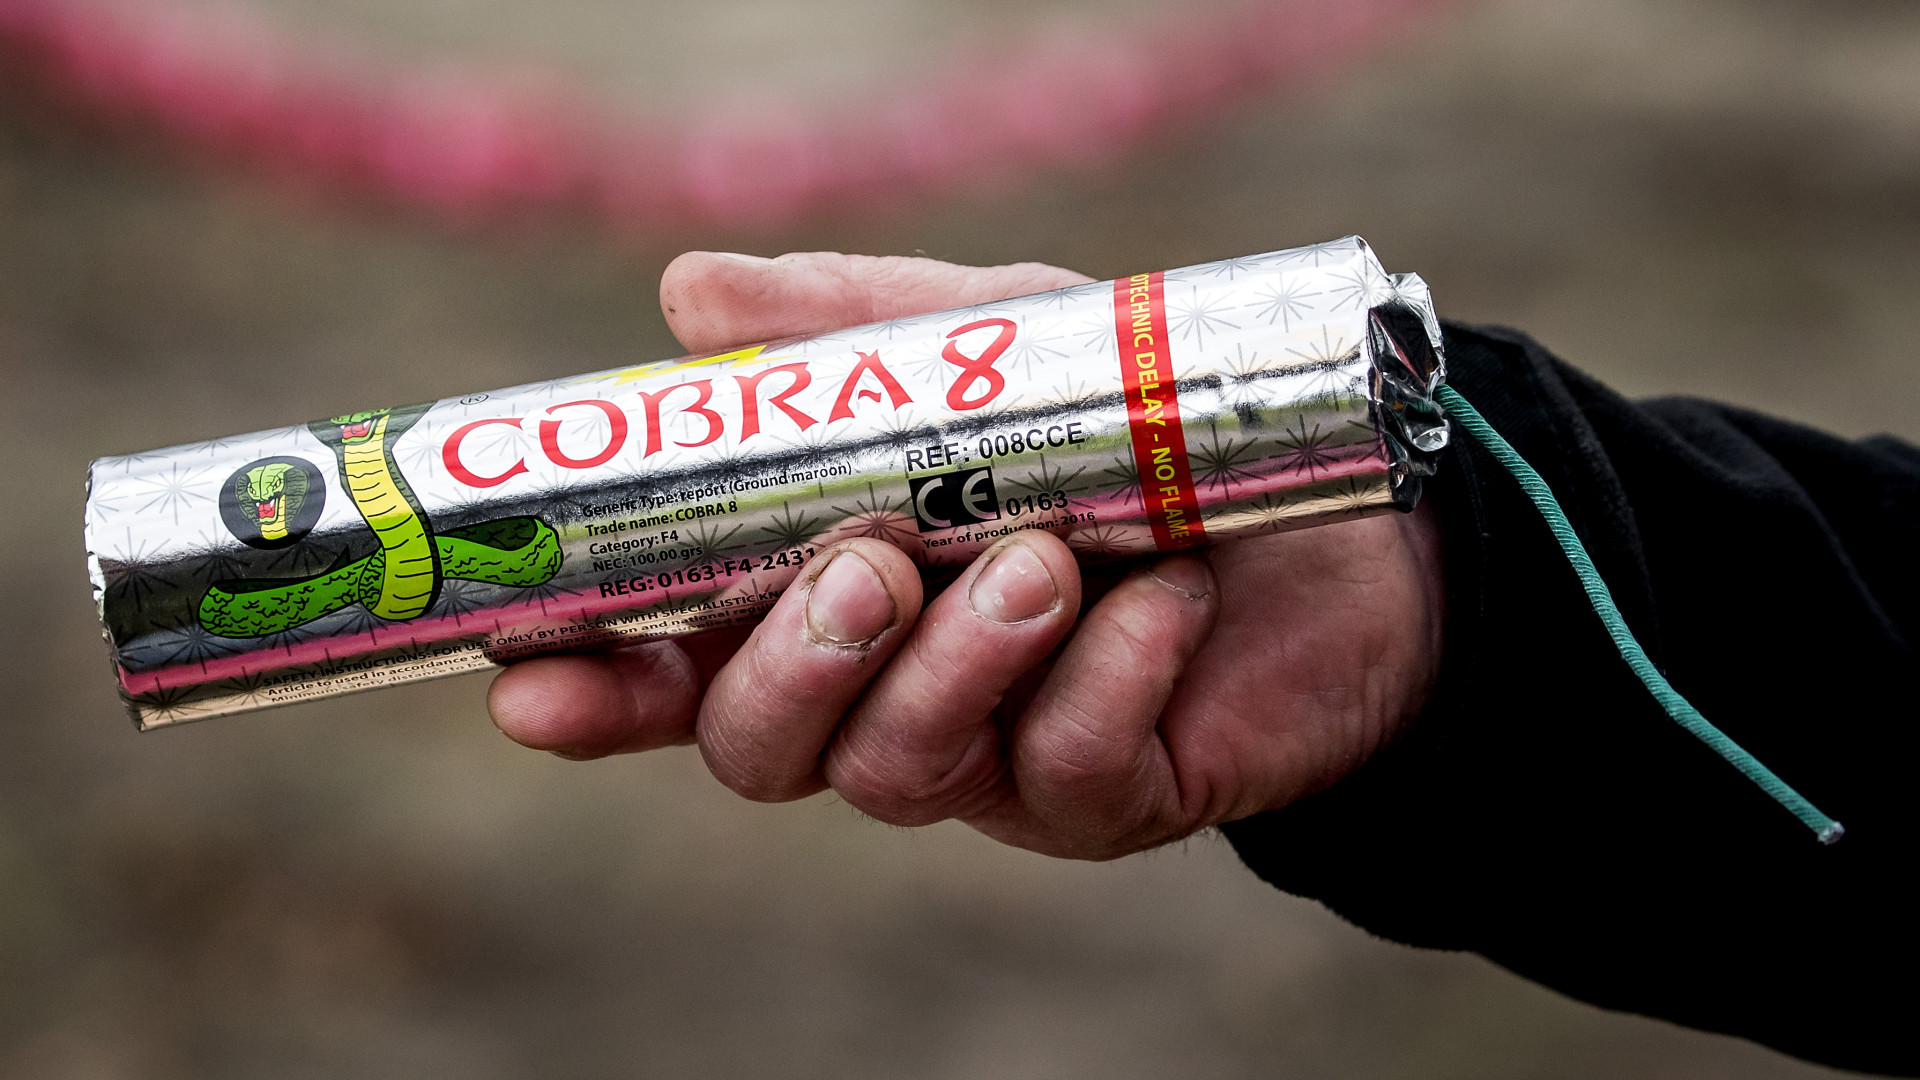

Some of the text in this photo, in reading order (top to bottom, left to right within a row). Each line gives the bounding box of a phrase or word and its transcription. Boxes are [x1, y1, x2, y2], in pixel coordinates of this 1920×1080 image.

[441, 318, 1018, 489] COBRA 8
[1135, 351, 1166, 427] DELAY
[906, 422, 1085, 471] REF: 008CCE
[1152, 433, 1161, 443] -
[1151, 446, 1176, 482] NO
[582, 461, 852, 518] Generic Type: report (Ground maroon)
[1005, 489, 1068, 516] 0163
[585, 501, 738, 537] Trade name: COBRA 8
[922, 536, 952, 549] Year
[957, 531, 972, 543] of
[1061, 511, 1095, 525] 2016
[1158, 485, 1190, 540] FLAME
[589, 529, 679, 555] Category: F4
[593, 546, 703, 573] NEC: 100,00 grs
[600, 576, 655, 598] REG:
[263, 669, 317, 687] SAFETY
[320, 651, 432, 677] INSTRUCTIONS:
[432, 644, 463, 658] FOR
[464, 639, 494, 651] USE
[496, 632, 534, 646] ONLY
[537, 629, 556, 639] BY
[559, 618, 618, 635] PERSON
[618, 611, 658, 625] WITH
[661, 594, 756, 618] SPECIALISTIC
[268, 682, 314, 696] Article
[318, 680, 332, 688] to
[335, 672, 369, 684] used
[371, 669, 386, 678] in
[389, 655, 468, 675] accordance
[471, 648, 503, 660] with
[560, 628, 638, 645] instruction
[641, 621, 668, 631] and
[271, 688, 339, 702] Minimum
